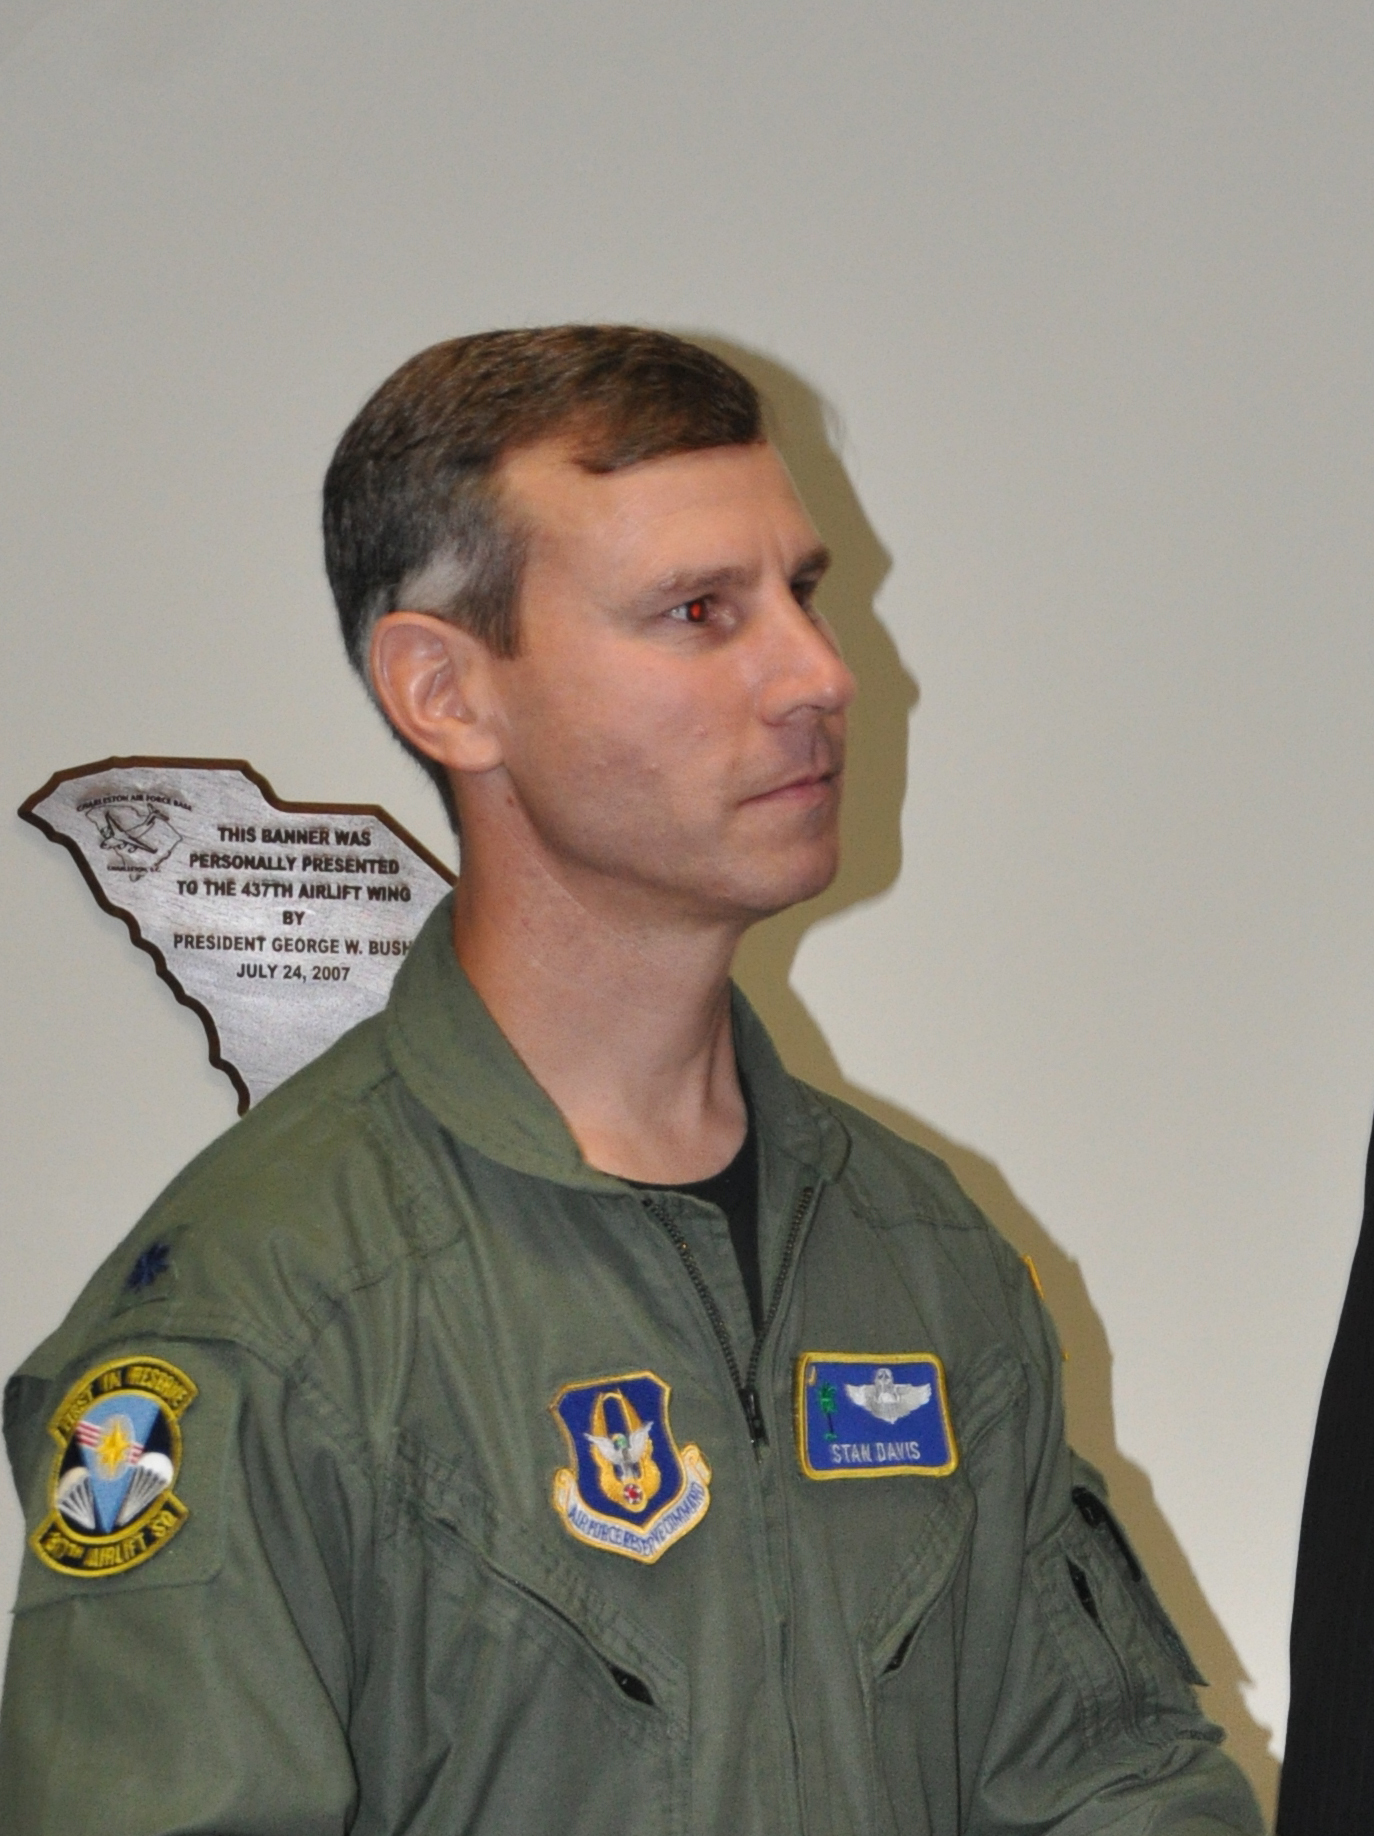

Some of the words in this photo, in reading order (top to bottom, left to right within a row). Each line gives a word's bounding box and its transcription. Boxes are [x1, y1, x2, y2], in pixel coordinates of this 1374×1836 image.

[217, 826, 257, 843] THIS
[261, 828, 330, 846] BANNER
[334, 829, 372, 846] WAS
[189, 852, 298, 871] PERSONALLY
[302, 855, 400, 874] PRESENTED
[177, 880, 198, 896] TO
[203, 879, 236, 896] THE
[241, 881, 293, 898] 437TH
[298, 884, 363, 900] AIRLIFT
[366, 886, 411, 902] WING
[282, 910, 306, 926] BY
[173, 932, 267, 952] PRESIDENT
[271, 937, 340, 954] GEORGE
[344, 939, 363, 955] W.
[368, 940, 412, 956] BUSH
[236, 963, 278, 979] JULY
[283, 964, 307, 984] 24,
[312, 965, 351, 982] 2007
[831, 1443, 873, 1464] STAN
[875, 1441, 922, 1462] DAVIS
[567, 1503, 590, 1528] AIR
[587, 1519, 623, 1546] FORCE
[623, 1523, 668, 1557] RESERVE
[664, 1481, 706, 1535] COMMAND
[83, 1531, 147, 1567] AIRLIFT
